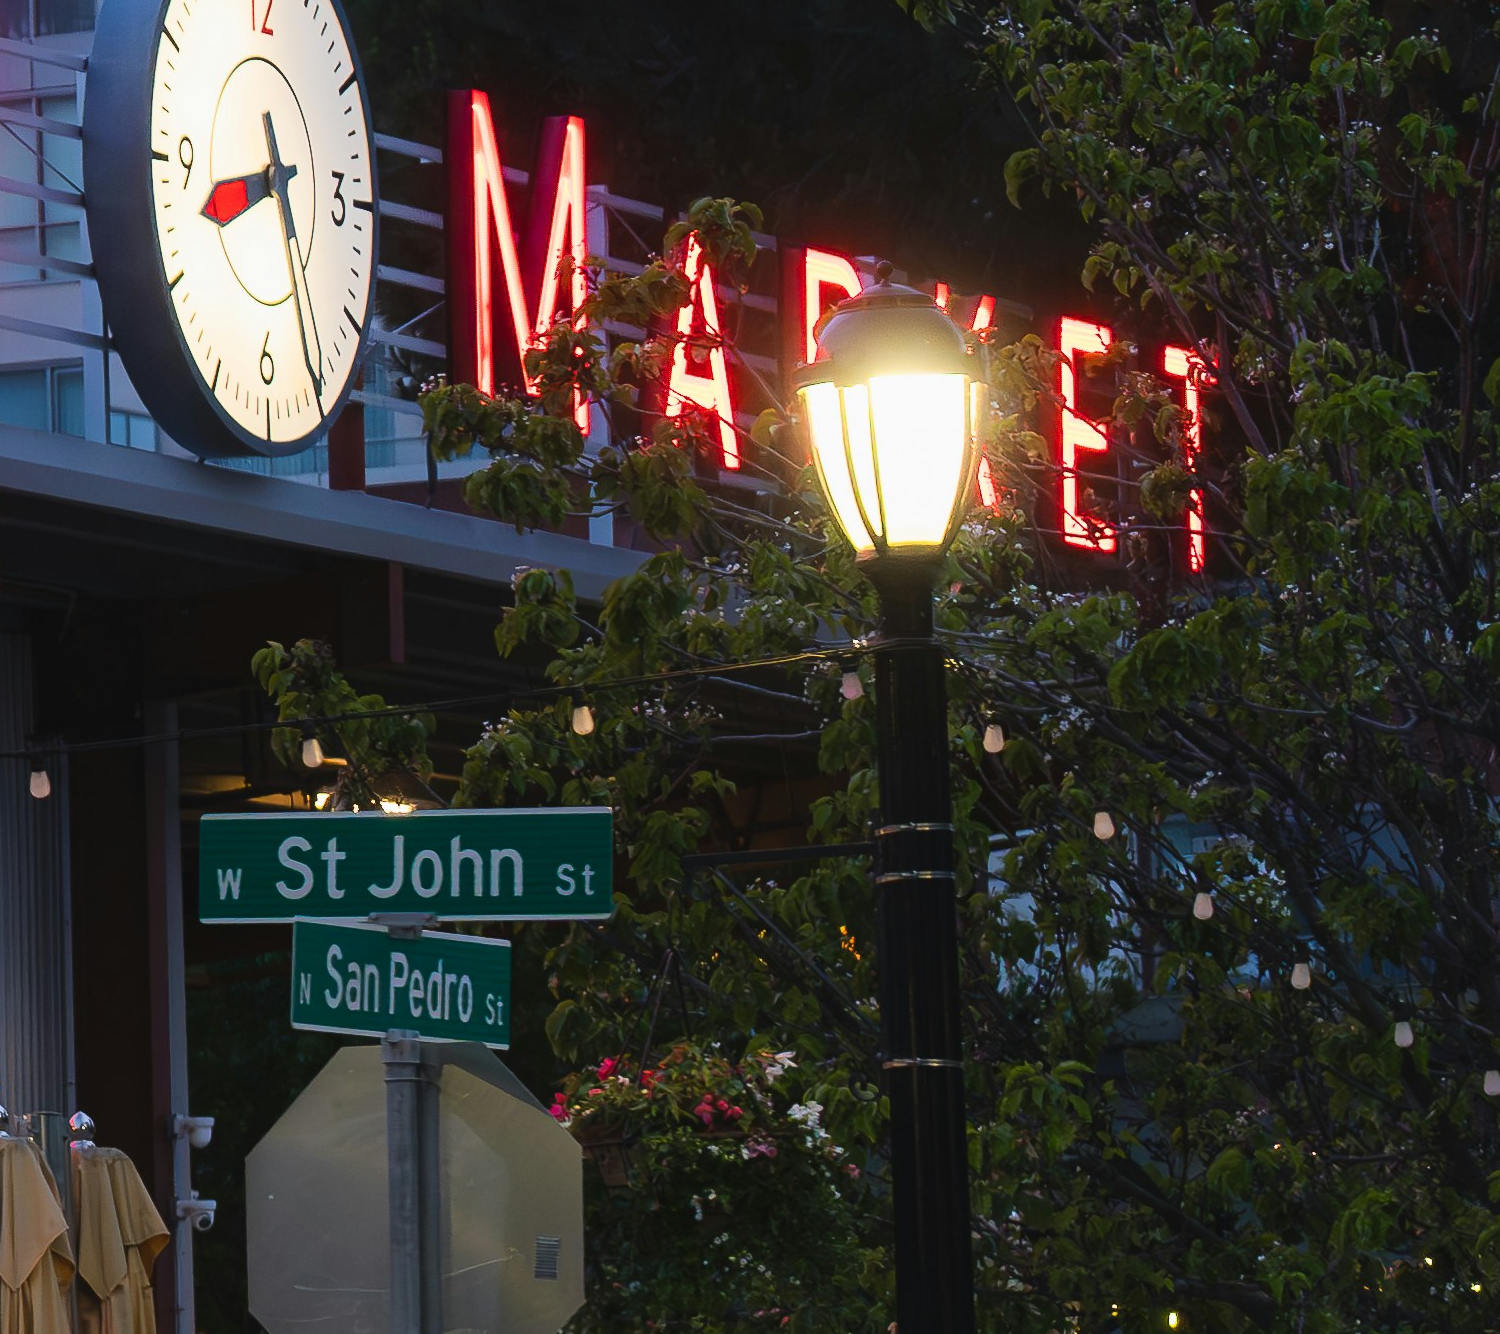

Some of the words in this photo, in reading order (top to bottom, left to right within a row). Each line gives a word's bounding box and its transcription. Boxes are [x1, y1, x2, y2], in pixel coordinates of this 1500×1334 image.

[178, 135, 194, 191] 9
[330, 171, 347, 226] 3
[259, 330, 276, 385] 6
[217, 868, 242, 900] W
[276, 836, 347, 900] St
[367, 834, 524, 899] John
[555, 864, 596, 897] St
[300, 972, 312, 1006] N
[324, 944, 380, 1013] San
[388, 952, 474, 1024] Pedro
[484, 992, 505, 1027] St
